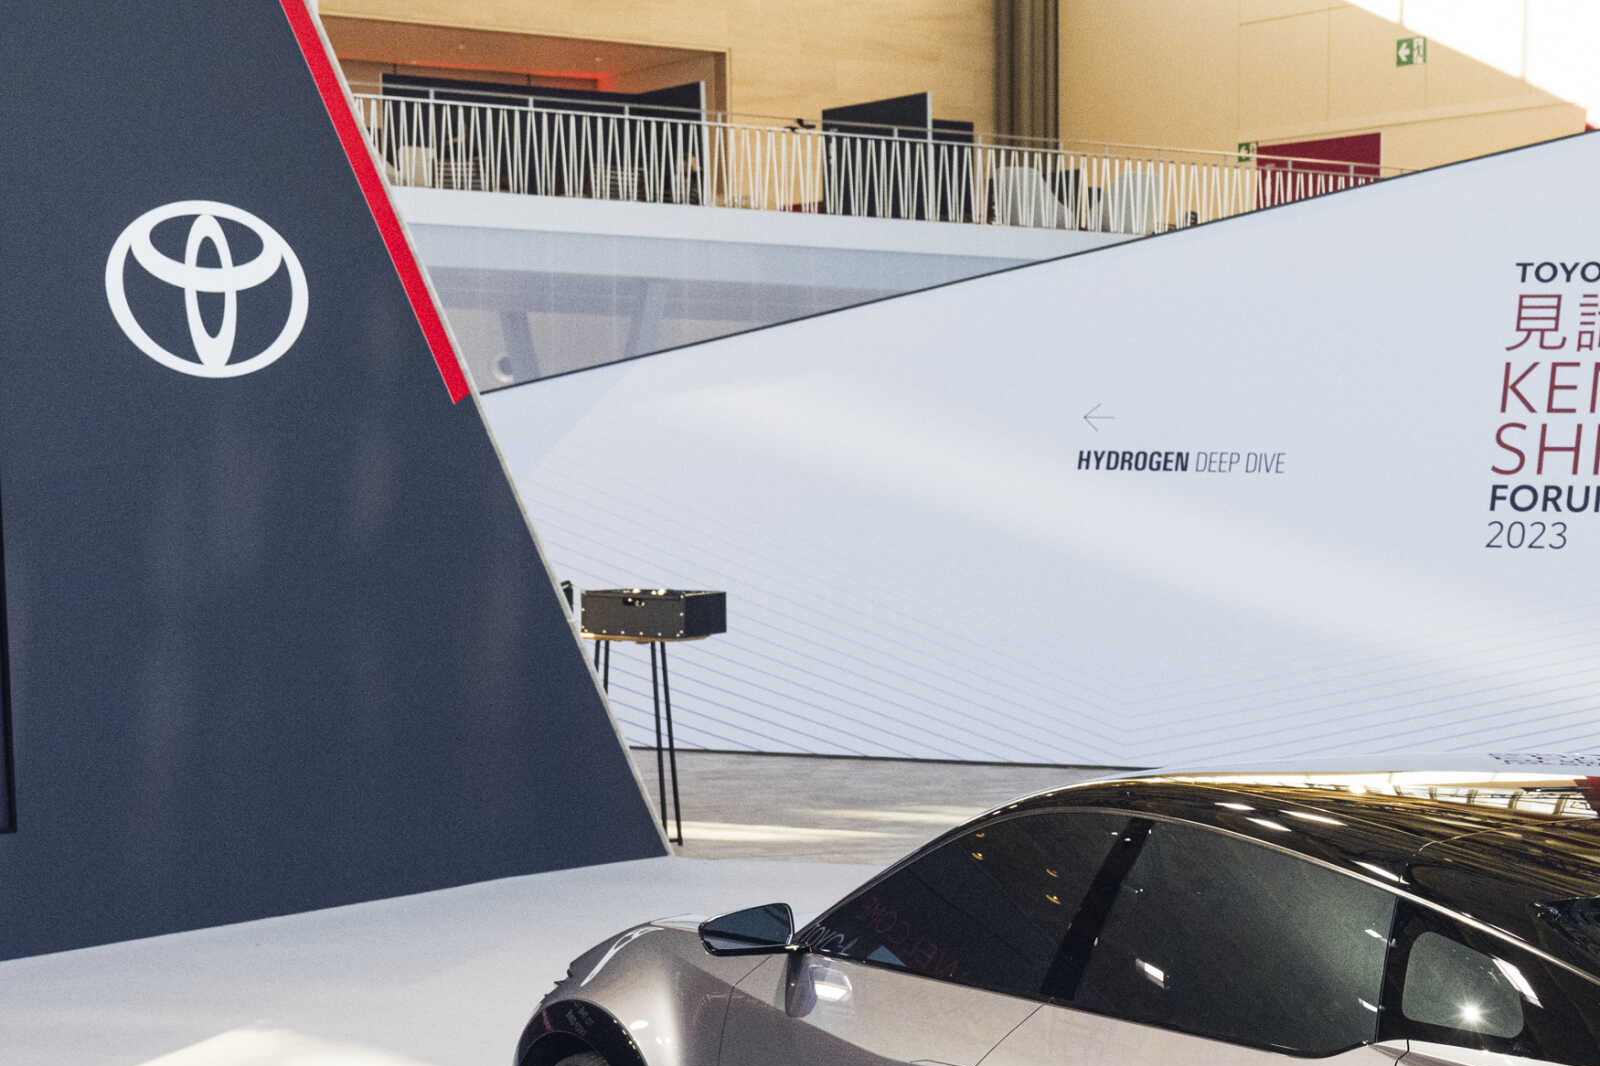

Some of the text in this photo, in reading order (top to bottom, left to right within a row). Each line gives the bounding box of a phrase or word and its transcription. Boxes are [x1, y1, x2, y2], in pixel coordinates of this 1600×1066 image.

[1077, 450, 1287, 474] HYDROGEN DEEP DIVE
[1484, 520, 1568, 549] 2023
